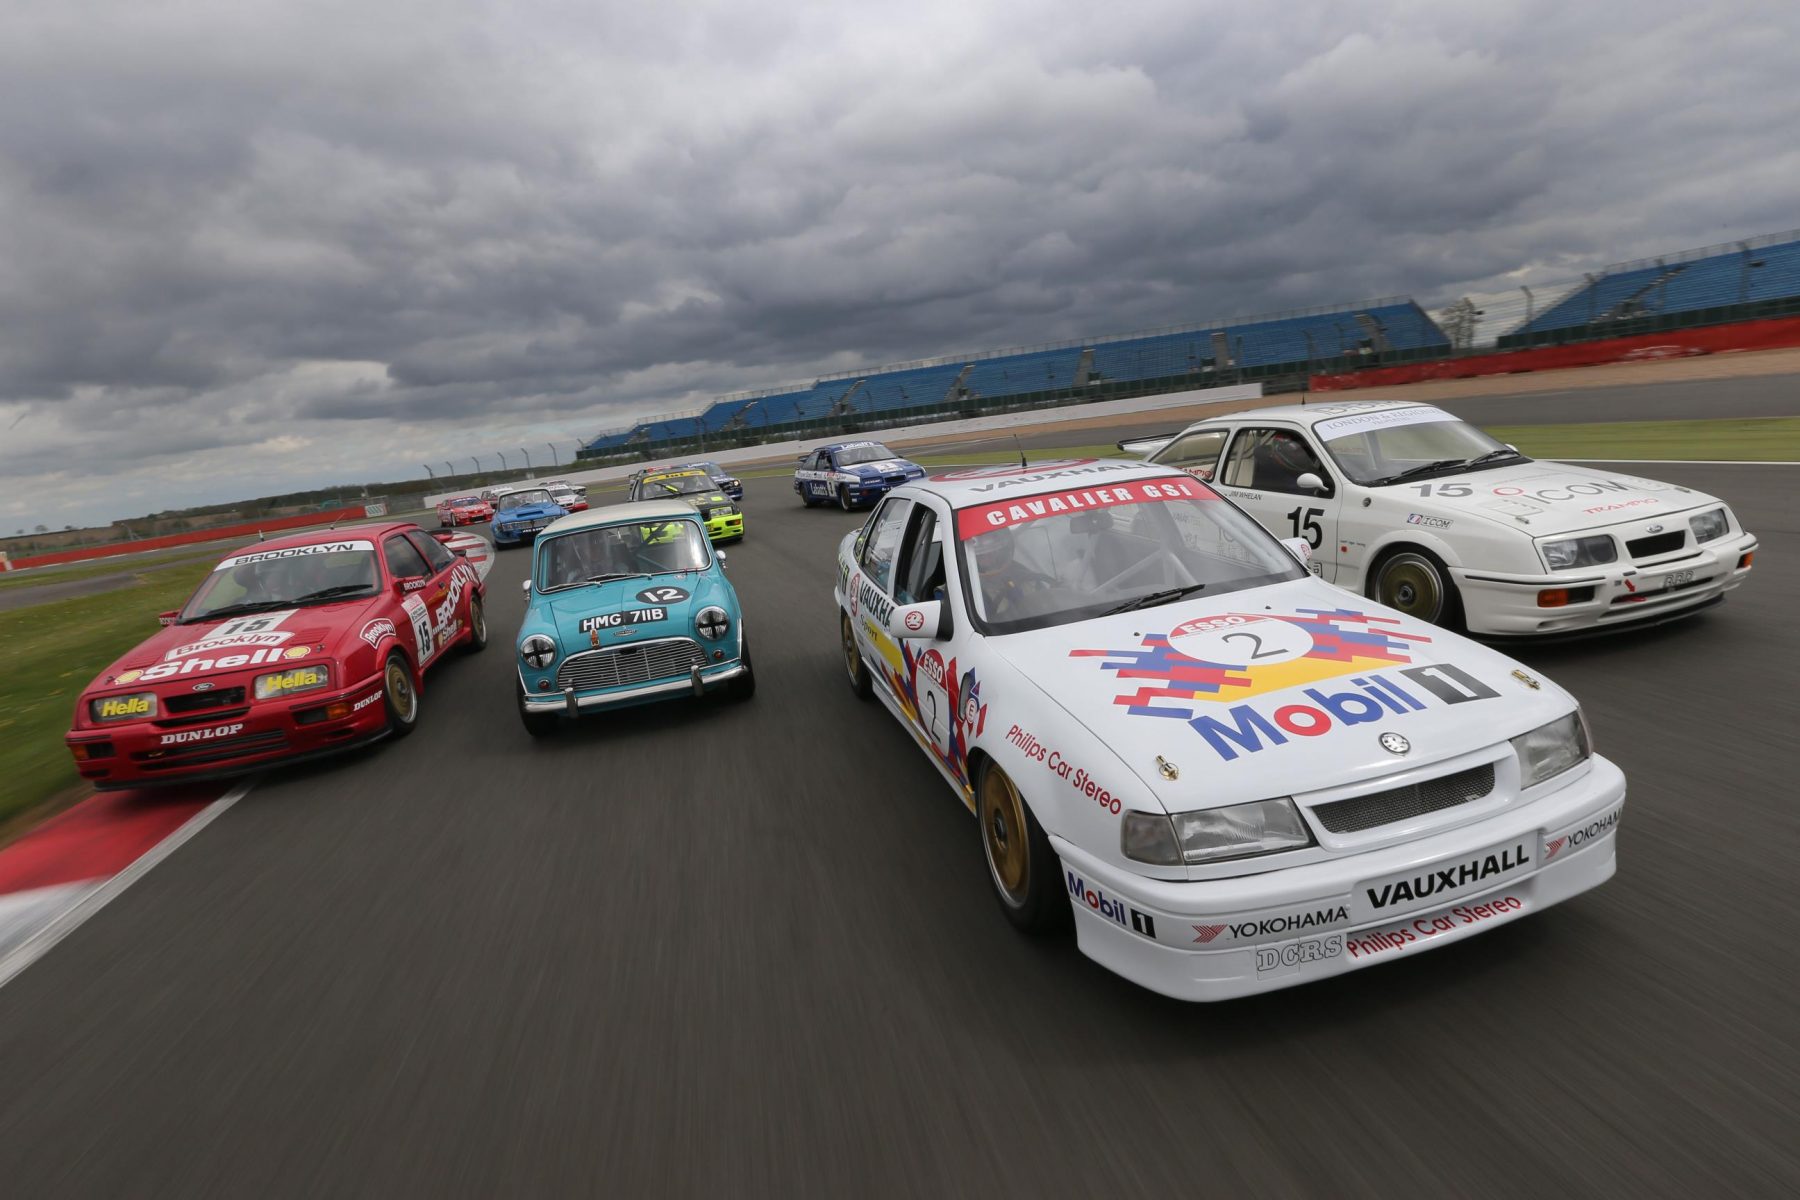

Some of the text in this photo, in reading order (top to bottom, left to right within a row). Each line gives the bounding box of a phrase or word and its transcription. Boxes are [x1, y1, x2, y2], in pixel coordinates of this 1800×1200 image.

[969, 462, 1159, 493] VAUXHALL
[1410, 483, 1473, 498] 15
[986, 486, 1134, 526] CAVALIER
[1229, 490, 1263, 501] JIM WHELAN
[1522, 480, 1629, 505] ICOM
[1287, 506, 1325, 550] 15
[1422, 517, 1450, 528] ICOM
[234, 542, 354, 566] BROOKLYN
[436, 563, 480, 629] BROOKLYN
[643, 588, 684, 603] 12
[859, 580, 895, 629] VAUXHA
[224, 617, 275, 635] 15
[364, 620, 395, 643] Brooklyn
[583, 608, 664, 631] HMG 711B
[860, 614, 878, 640] Sport
[1180, 616, 1247, 633] ESSO
[176, 634, 281, 656] Brooklyn
[418, 621, 431, 655] 15
[1222, 632, 1289, 660] 2
[139, 648, 284, 681] Shell
[924, 653, 943, 683] ESSO
[266, 671, 318, 691] Hella
[102, 697, 149, 717] Hella
[353, 690, 383, 711] DUNLOP
[927, 690, 941, 744] 2
[1187, 674, 1428, 762] Mobil
[160, 723, 244, 745] DUNLOP
[1005, 724, 1122, 815] Philips Car Stereo
[1567, 808, 1621, 848] YOKOHAM
[1366, 844, 1530, 909] VAUXHALL
[1067, 871, 1127, 926] Mobil
[1229, 906, 1349, 939] YOKOHAMA
[1346, 896, 1522, 958] Philips Car Stereo
[1256, 935, 1343, 972] DCRS
